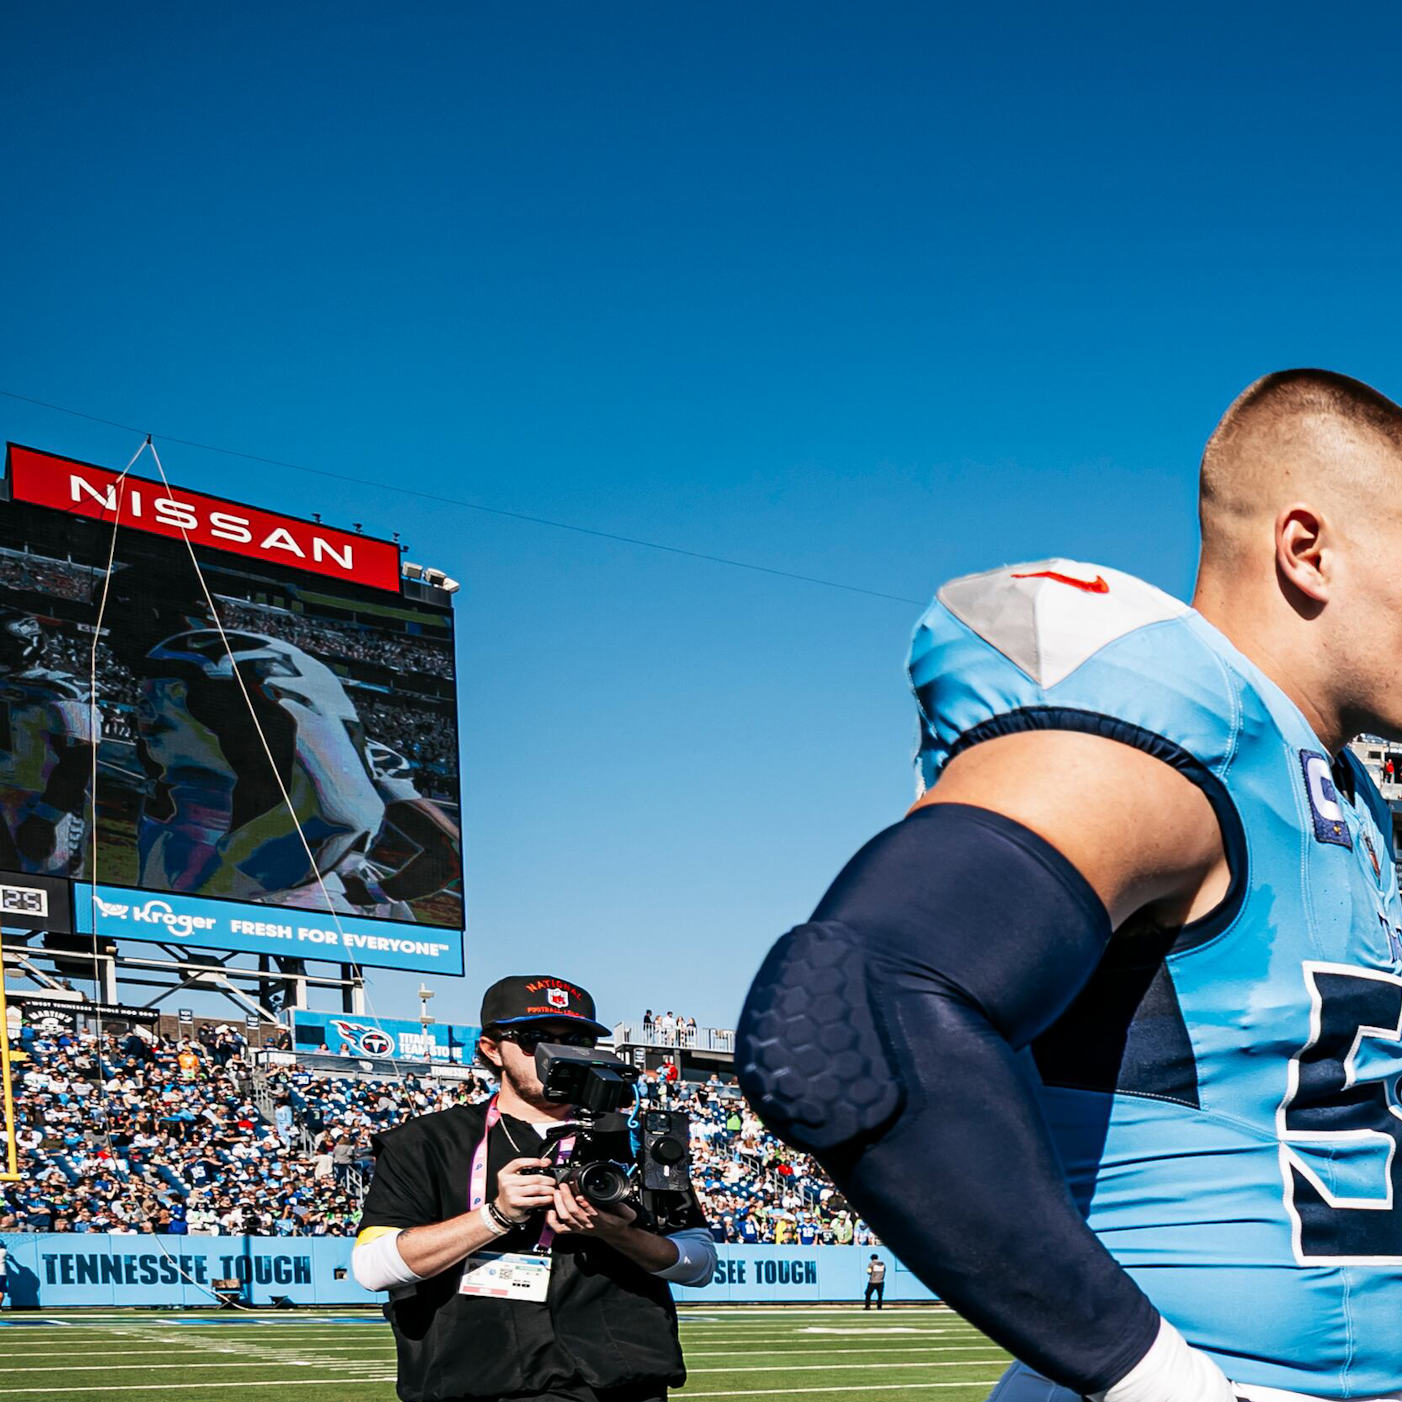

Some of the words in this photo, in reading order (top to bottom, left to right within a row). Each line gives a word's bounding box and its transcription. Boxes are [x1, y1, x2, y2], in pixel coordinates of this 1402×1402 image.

[70, 474, 353, 570] NISSAN
[5, 890, 40, 911] 25
[133, 900, 216, 937] Kroger
[230, 919, 293, 940] FRESH
[297, 927, 339, 946] FOR
[525, 979, 584, 1000] NATIONAL
[399, 1032, 436, 1046] TITAS
[41, 1253, 208, 1285] TENNESSEE
[219, 1254, 312, 1285] TOUGH
[754, 1259, 817, 1285] TOUGH
